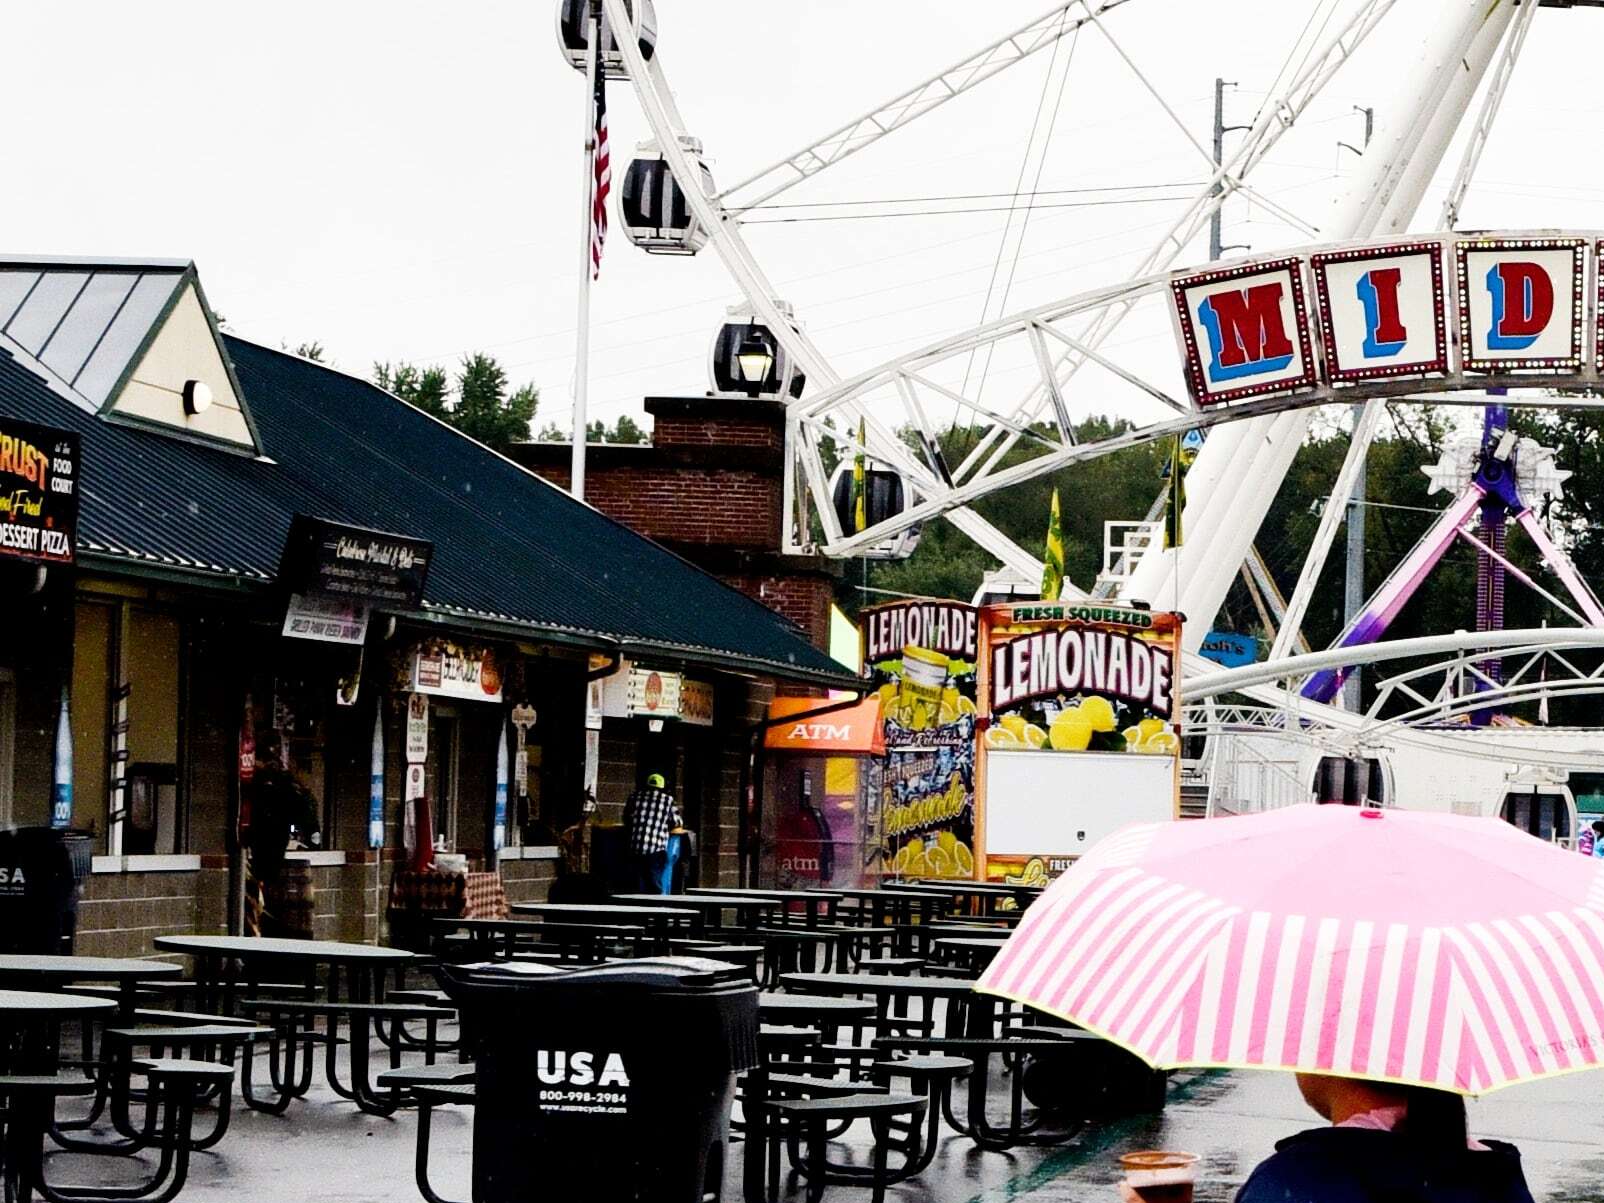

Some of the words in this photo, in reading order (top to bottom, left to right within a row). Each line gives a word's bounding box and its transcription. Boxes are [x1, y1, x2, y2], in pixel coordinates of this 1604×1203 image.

[0, 431, 49, 491] RUST
[53, 457, 72, 475] FOOD
[51, 477, 73, 494] COURT
[41, 529, 70, 556] PIZZA
[1013, 606, 1064, 623] FRESH
[1068, 606, 1152, 629] SQUEEZED
[868, 606, 977, 658] LEMONADE
[994, 629, 1170, 712] LEMONADE
[788, 724, 851, 741] ATM
[782, 856, 820, 871] atm
[0, 868, 25, 884] SA
[537, 1050, 630, 1087] USA
[539, 1090, 627, 1104] 800-998-2984
